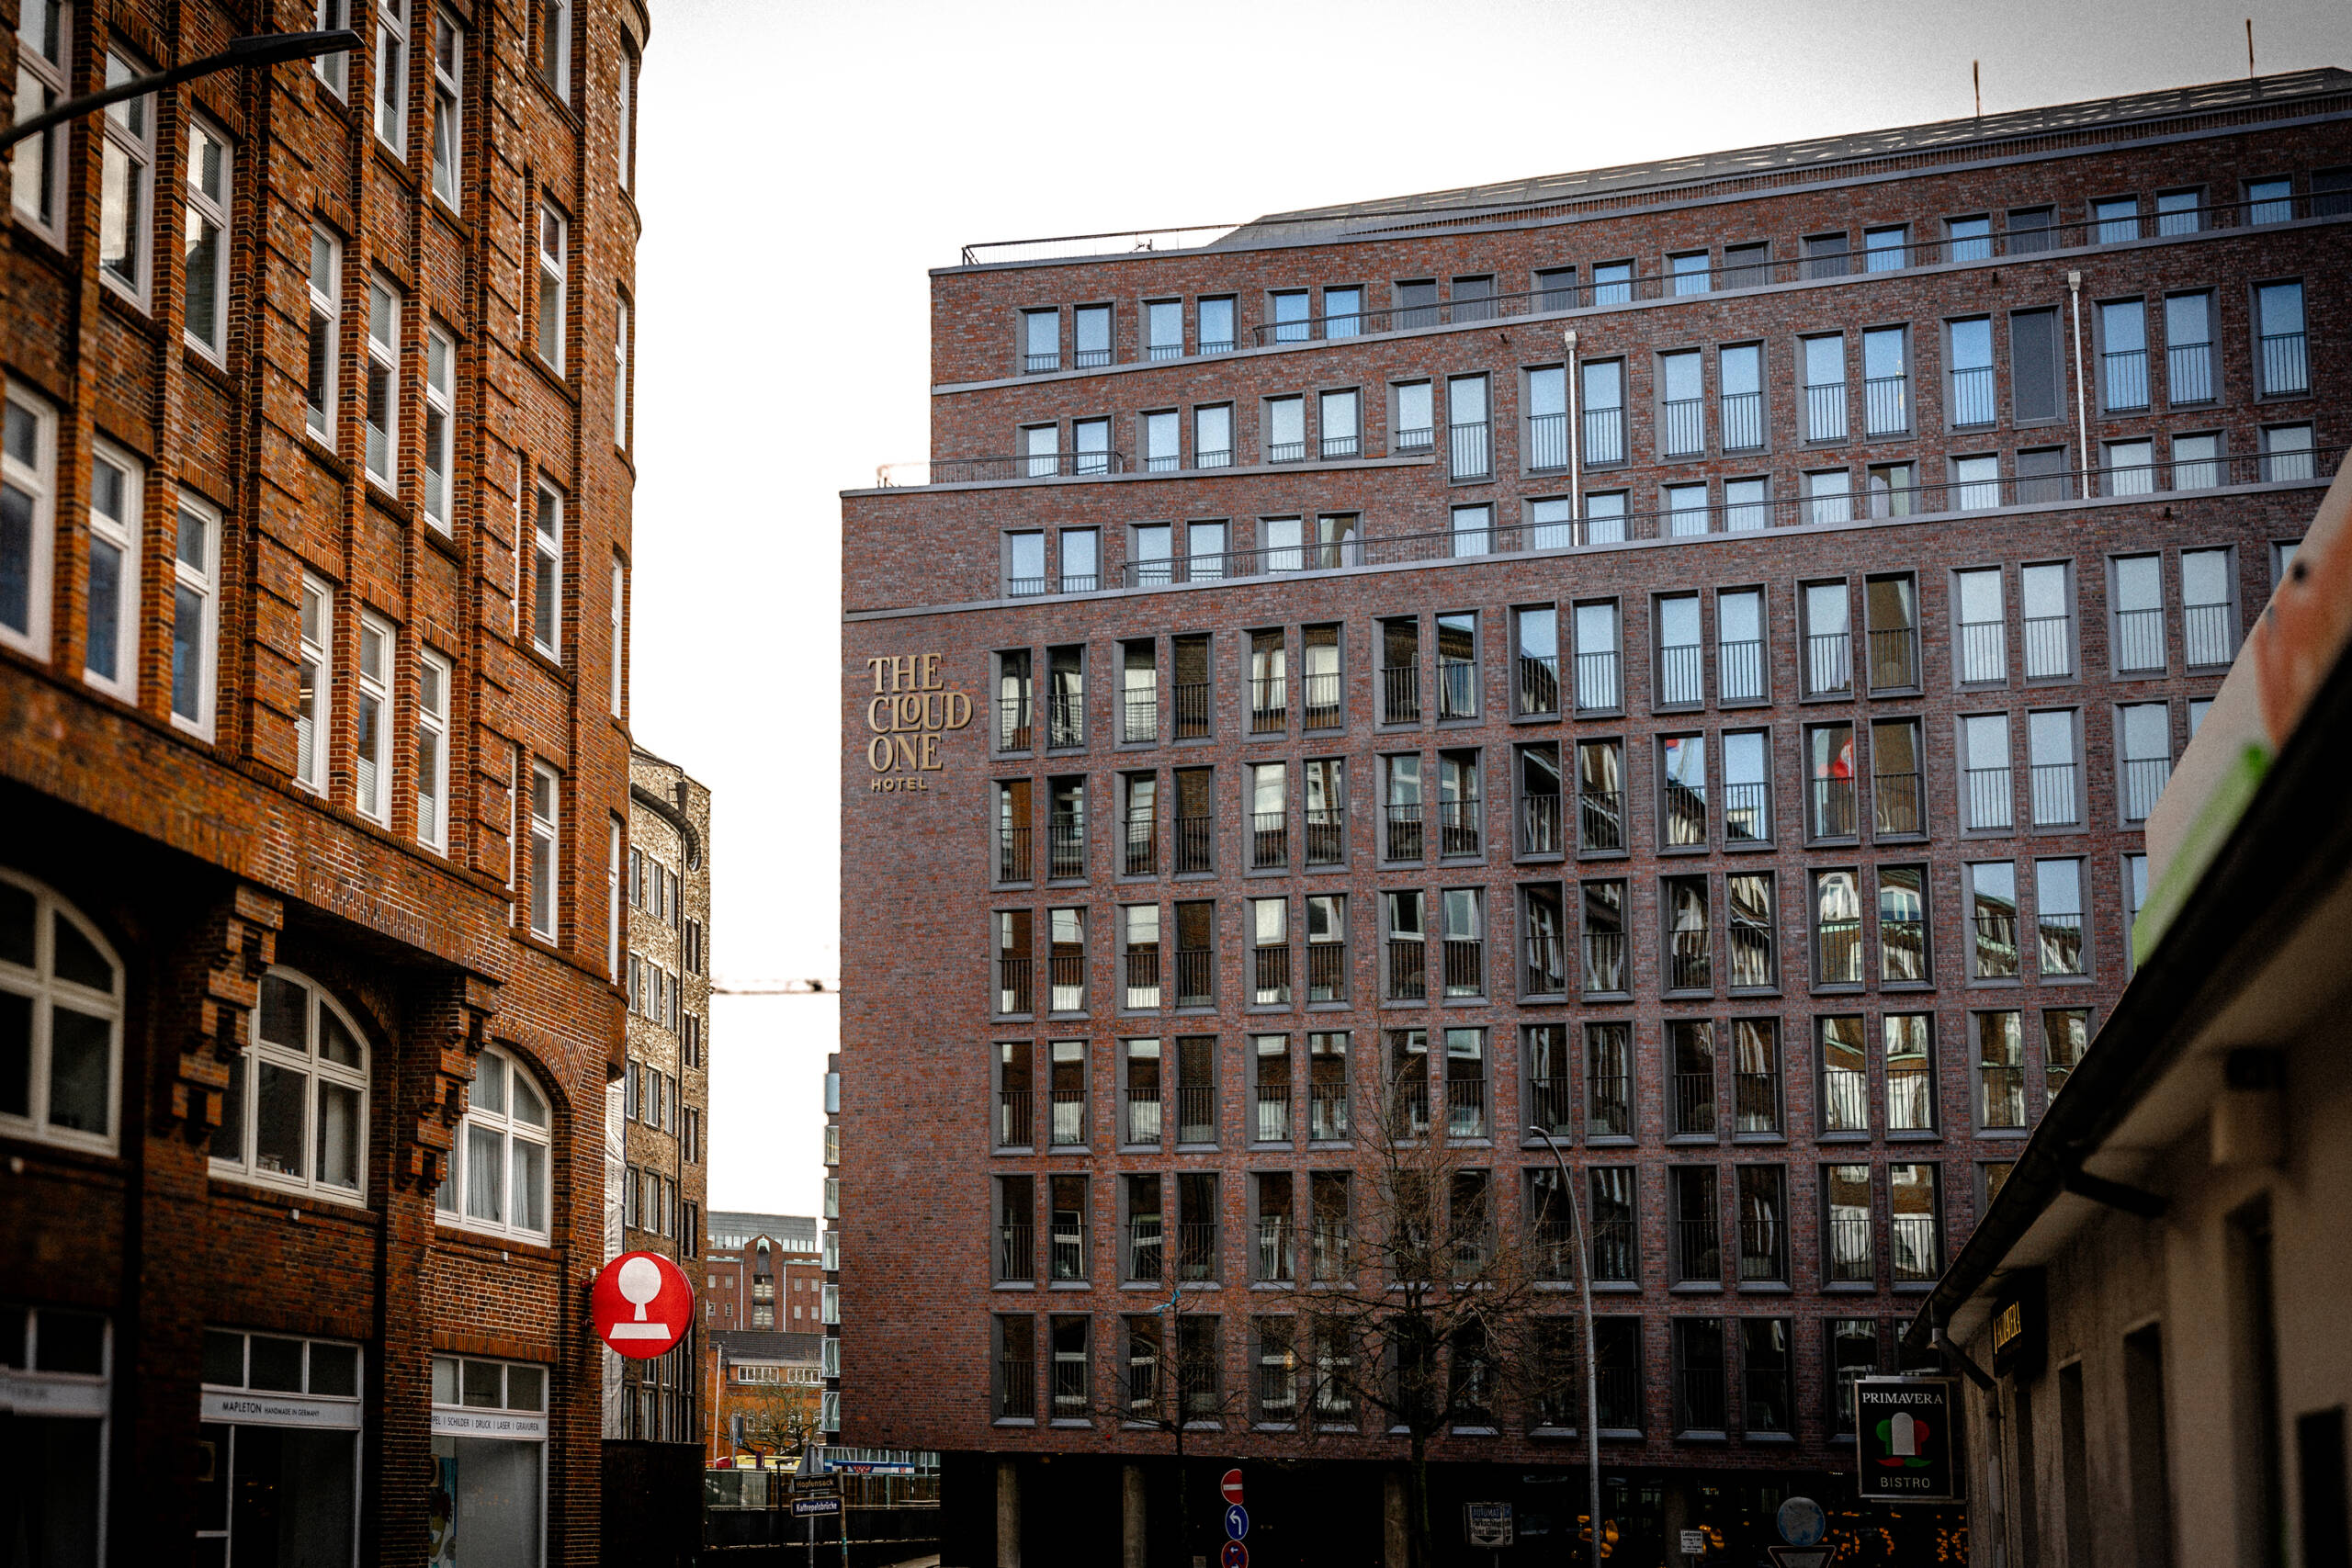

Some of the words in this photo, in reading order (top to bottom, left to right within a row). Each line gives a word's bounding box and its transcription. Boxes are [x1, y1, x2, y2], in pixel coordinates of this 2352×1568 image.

[867, 653, 944, 694] THE
[867, 692, 973, 734] CLOUD
[867, 734, 943, 773] ONE
[871, 778, 928, 792] HOTEL
[1861, 1392, 1943, 1404] PRIMAVERA
[222, 1402, 262, 1414] MAPLETON
[265, 1406, 291, 1416] HANDMADE
[432, 1416, 441, 1425] PEL
[447, 1416, 469, 1427] SCHILDER
[475, 1420, 492, 1428] DRUCK
[497, 1421, 510, 1430] LASER
[515, 1422, 539, 1431] GRAVUREN
[1880, 1476, 1930, 1488] BISTRO
